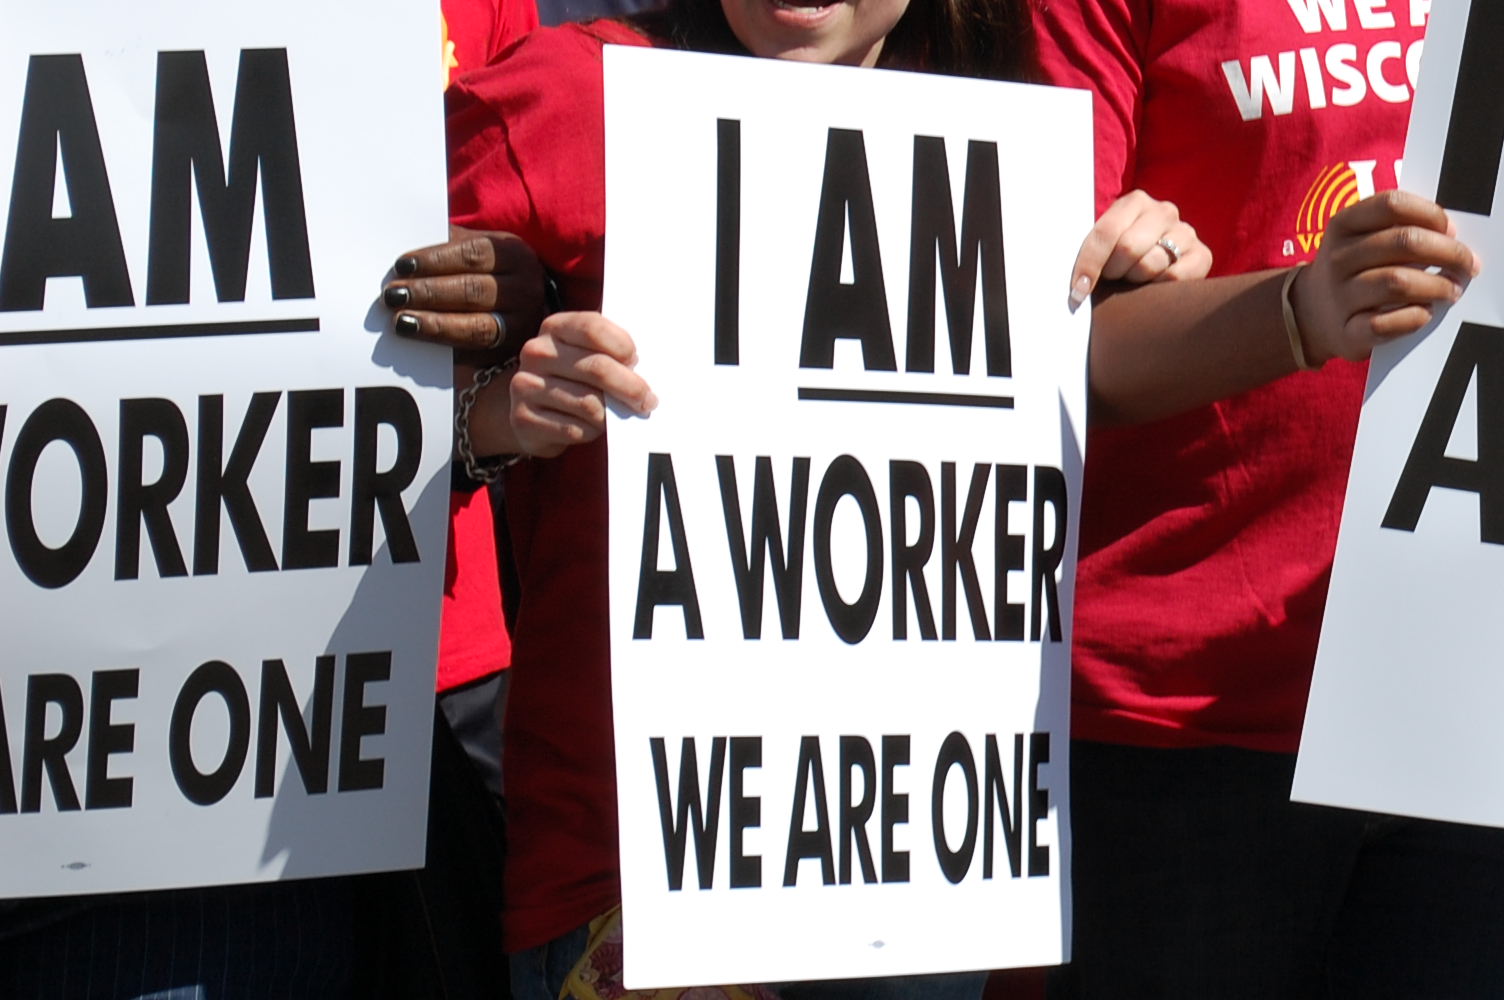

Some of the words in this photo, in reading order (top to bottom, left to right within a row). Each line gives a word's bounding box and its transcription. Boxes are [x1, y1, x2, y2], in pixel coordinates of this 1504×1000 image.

[0, 47, 316, 311] AM
[714, 117, 741, 366] I
[799, 126, 1013, 379] AM
[0, 386, 423, 590] ORKER
[632, 452, 705, 641] A
[714, 453, 1067, 646] WORKER
[168, 650, 393, 806] ONE
[649, 735, 763, 892] WE
[782, 733, 911, 887] ARE
[931, 730, 1051, 885] ONE
